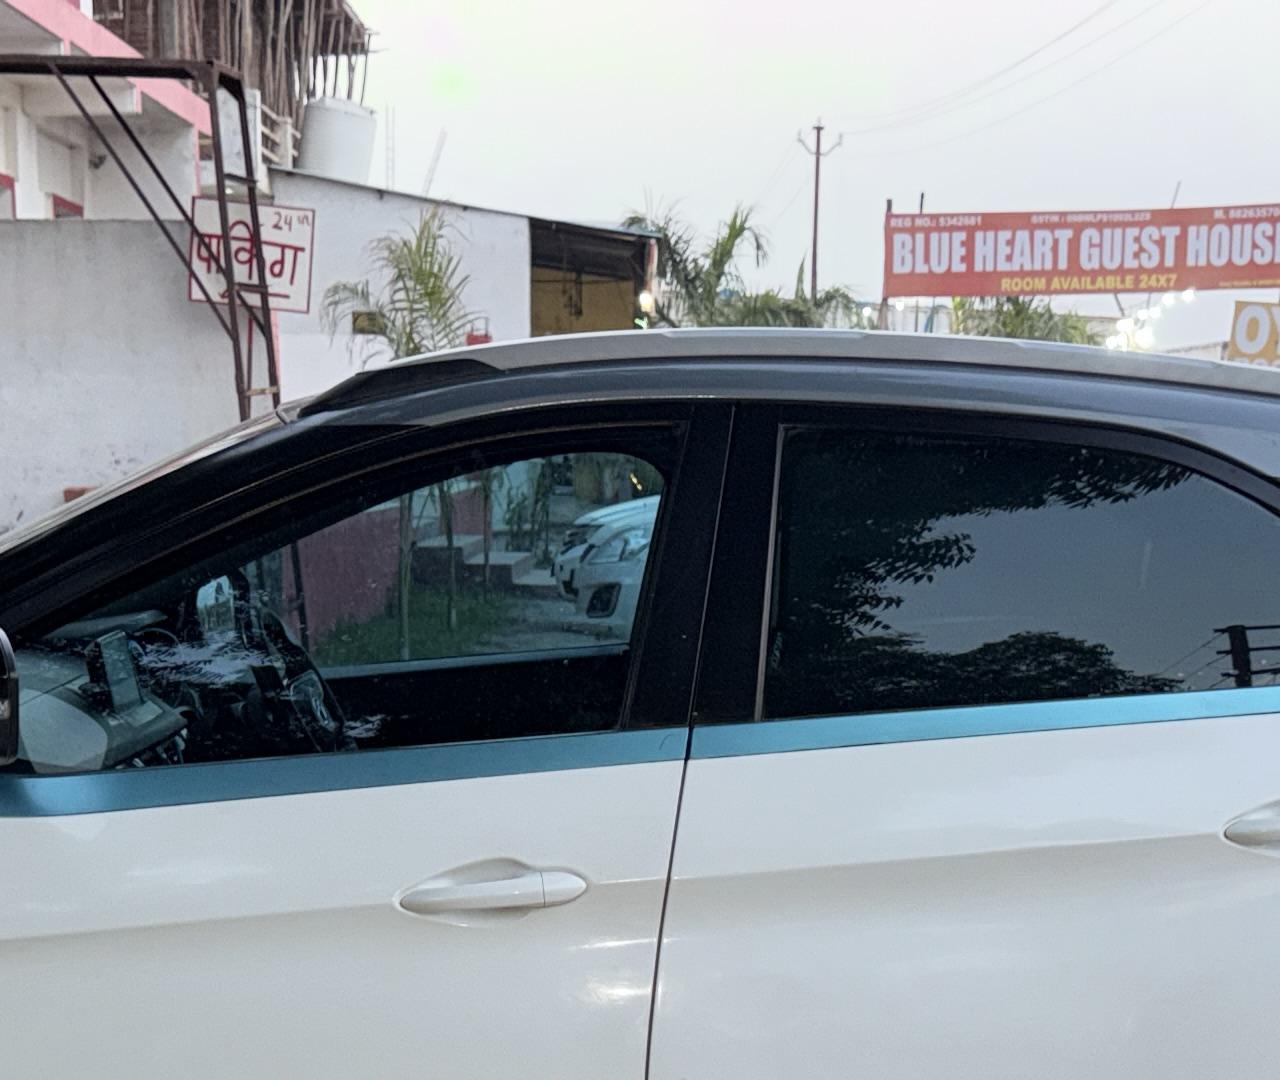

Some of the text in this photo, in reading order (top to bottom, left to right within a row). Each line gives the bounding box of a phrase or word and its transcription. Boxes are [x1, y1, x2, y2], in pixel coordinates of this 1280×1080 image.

[893, 232, 967, 273] BLUE
[974, 228, 1073, 271] HEART
[1080, 226, 1180, 270] GUEST
[1000, 272, 1178, 293] ROOM AVAILABLE 24X7
